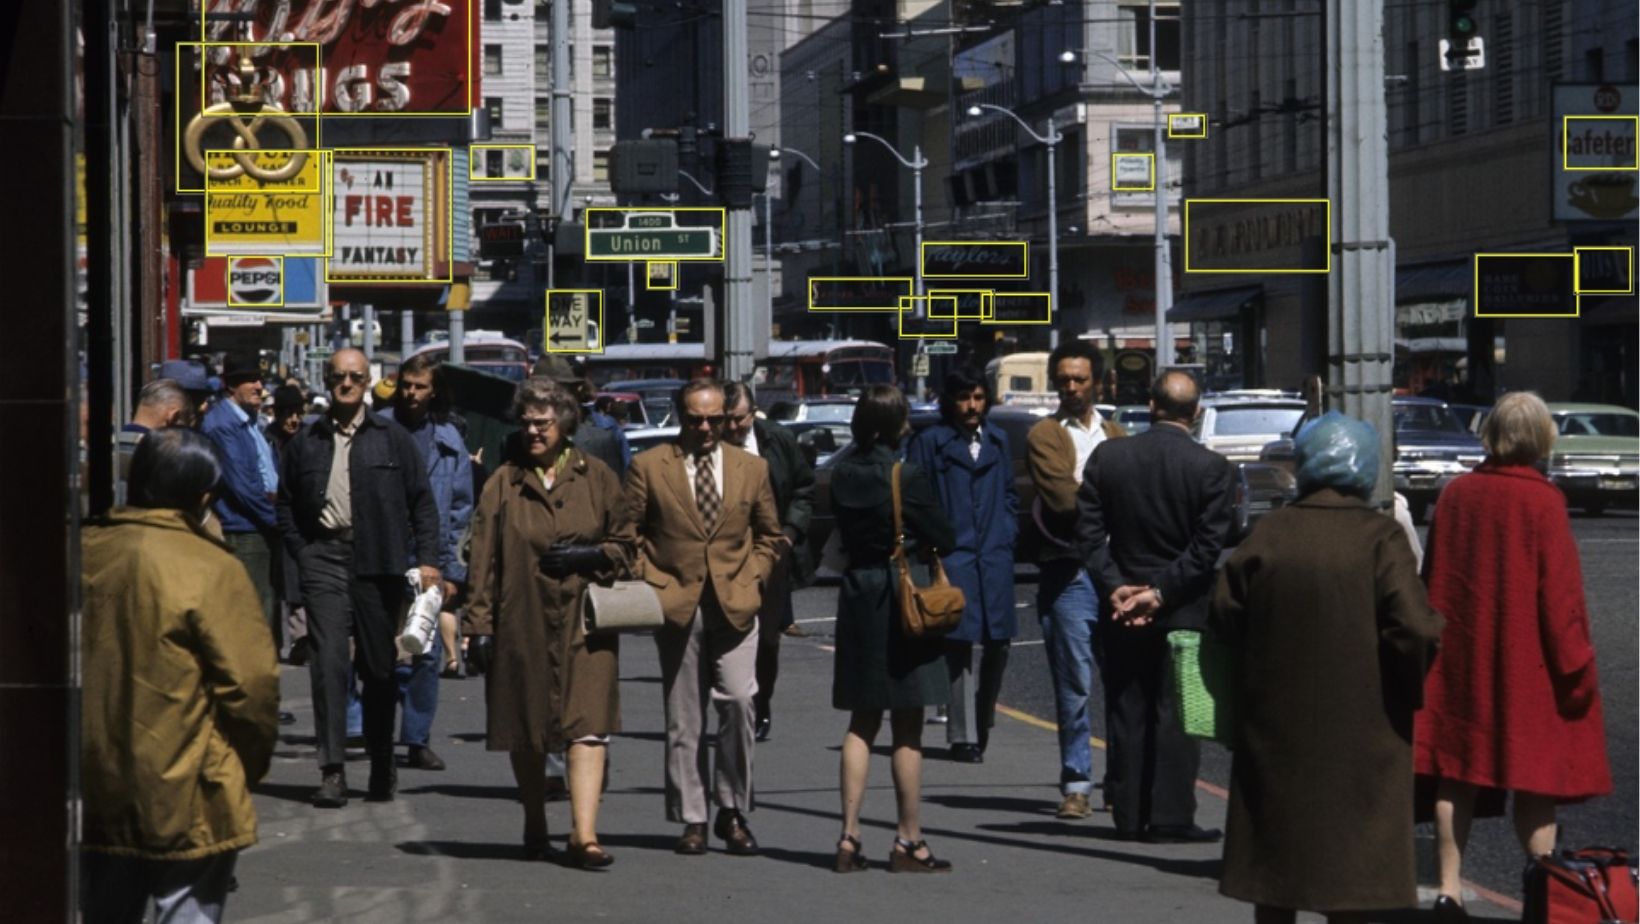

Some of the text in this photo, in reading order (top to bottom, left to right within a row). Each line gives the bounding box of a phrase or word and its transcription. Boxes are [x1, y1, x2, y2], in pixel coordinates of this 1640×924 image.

[374, 169, 394, 189] AN
[345, 195, 414, 227] FIRE
[221, 223, 289, 232] LOUNGE
[611, 233, 690, 252] Union ST
[342, 246, 418, 264] FANTASY
[230, 271, 282, 284] PEPSI
[551, 298, 582, 311] ONE
[550, 315, 582, 328] WAY
